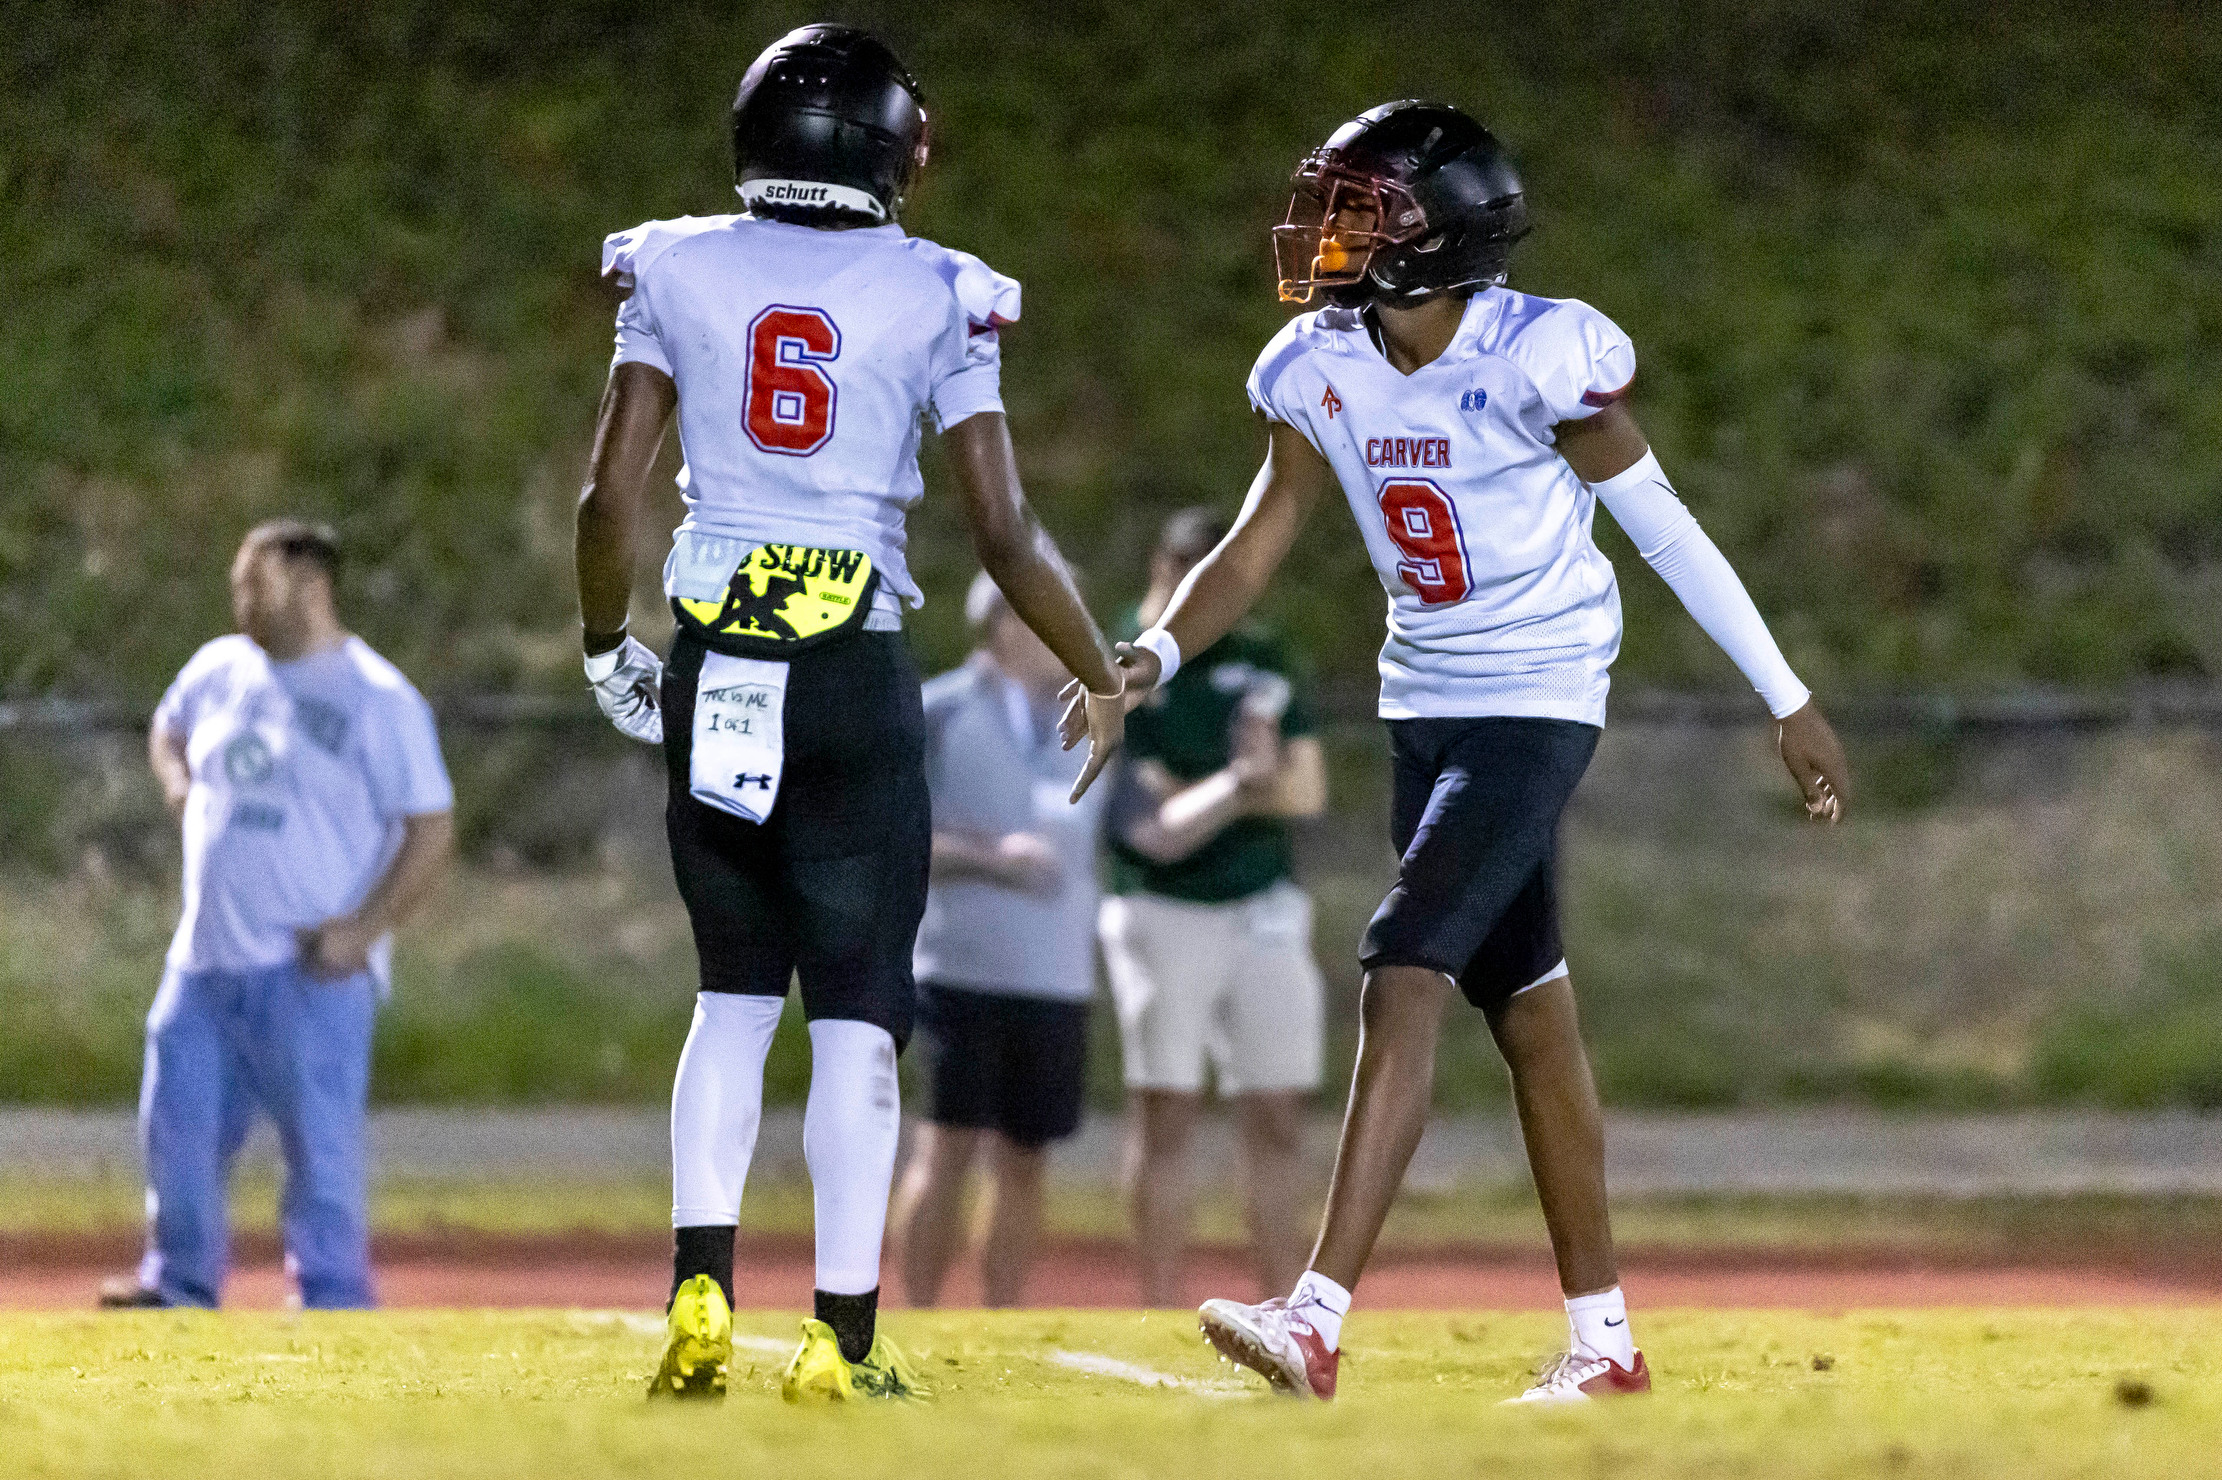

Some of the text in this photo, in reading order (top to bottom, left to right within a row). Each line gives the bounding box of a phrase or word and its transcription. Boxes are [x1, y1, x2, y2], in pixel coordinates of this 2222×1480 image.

[765, 183, 828, 201] schutt
[742, 304, 841, 457] 6
[1366, 437, 1452, 468] CARVER
[1377, 477, 1475, 606] 9
[760, 543, 864, 584] SLOW
[708, 713, 719, 731] 1
[738, 717, 753, 734] 1
